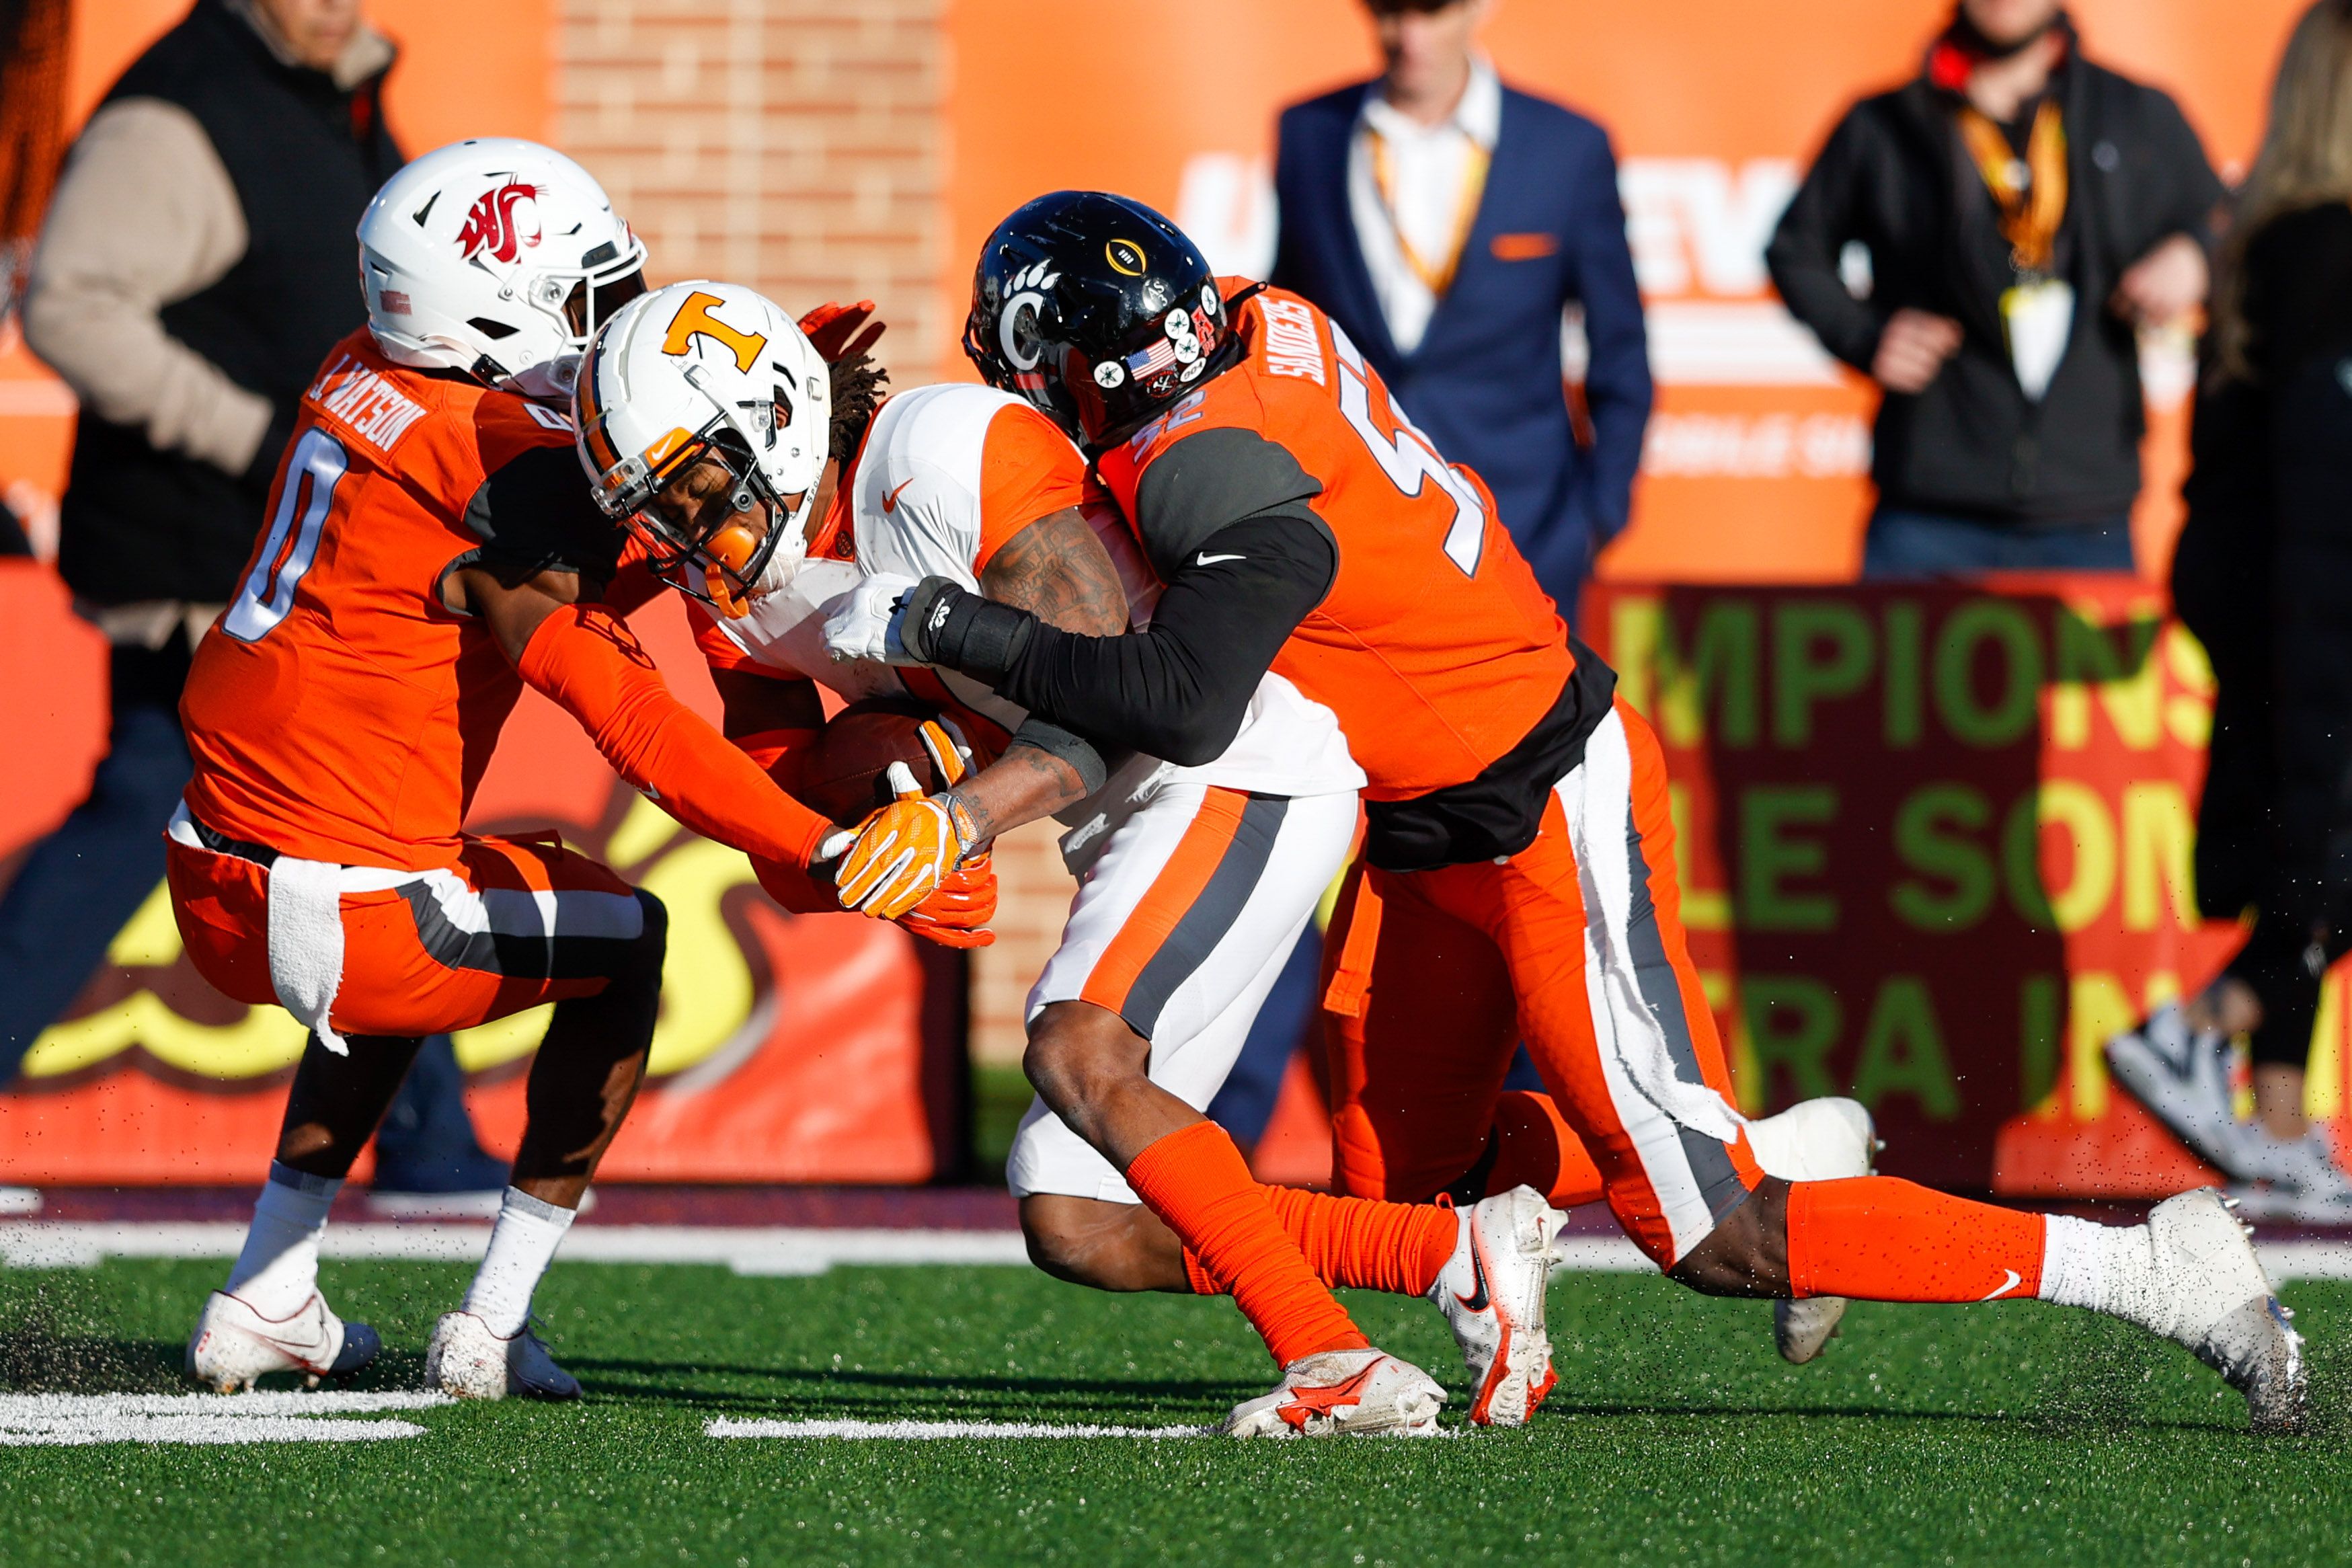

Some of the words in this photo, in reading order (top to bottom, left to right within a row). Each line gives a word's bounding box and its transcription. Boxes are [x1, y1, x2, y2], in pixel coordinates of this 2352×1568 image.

[661, 291, 769, 375] T
[323, 361, 428, 453] WATSON
[221, 426, 350, 643] 0
